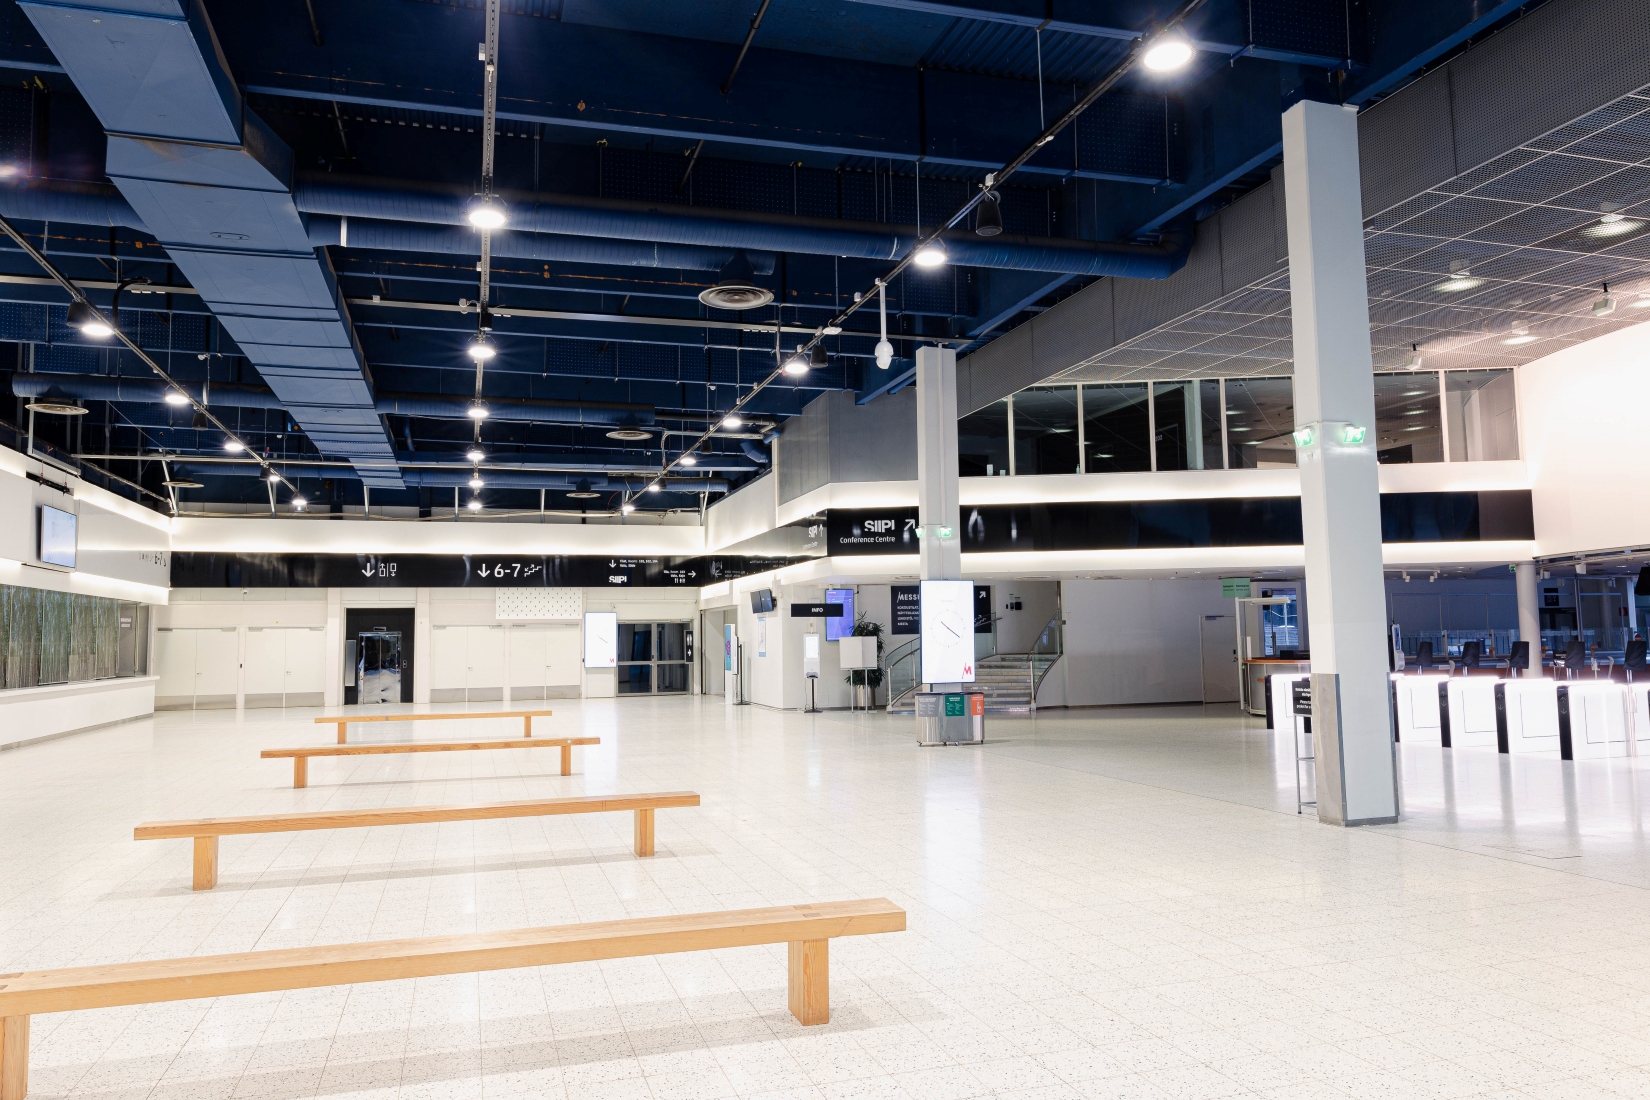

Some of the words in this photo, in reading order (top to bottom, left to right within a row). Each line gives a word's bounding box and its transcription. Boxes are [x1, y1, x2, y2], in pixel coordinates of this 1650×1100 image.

[864, 519, 895, 533] SIIPI
[840, 536, 874, 544] Conference
[494, 563, 521, 578] 6-7
[609, 575, 628, 584] SIIPI
